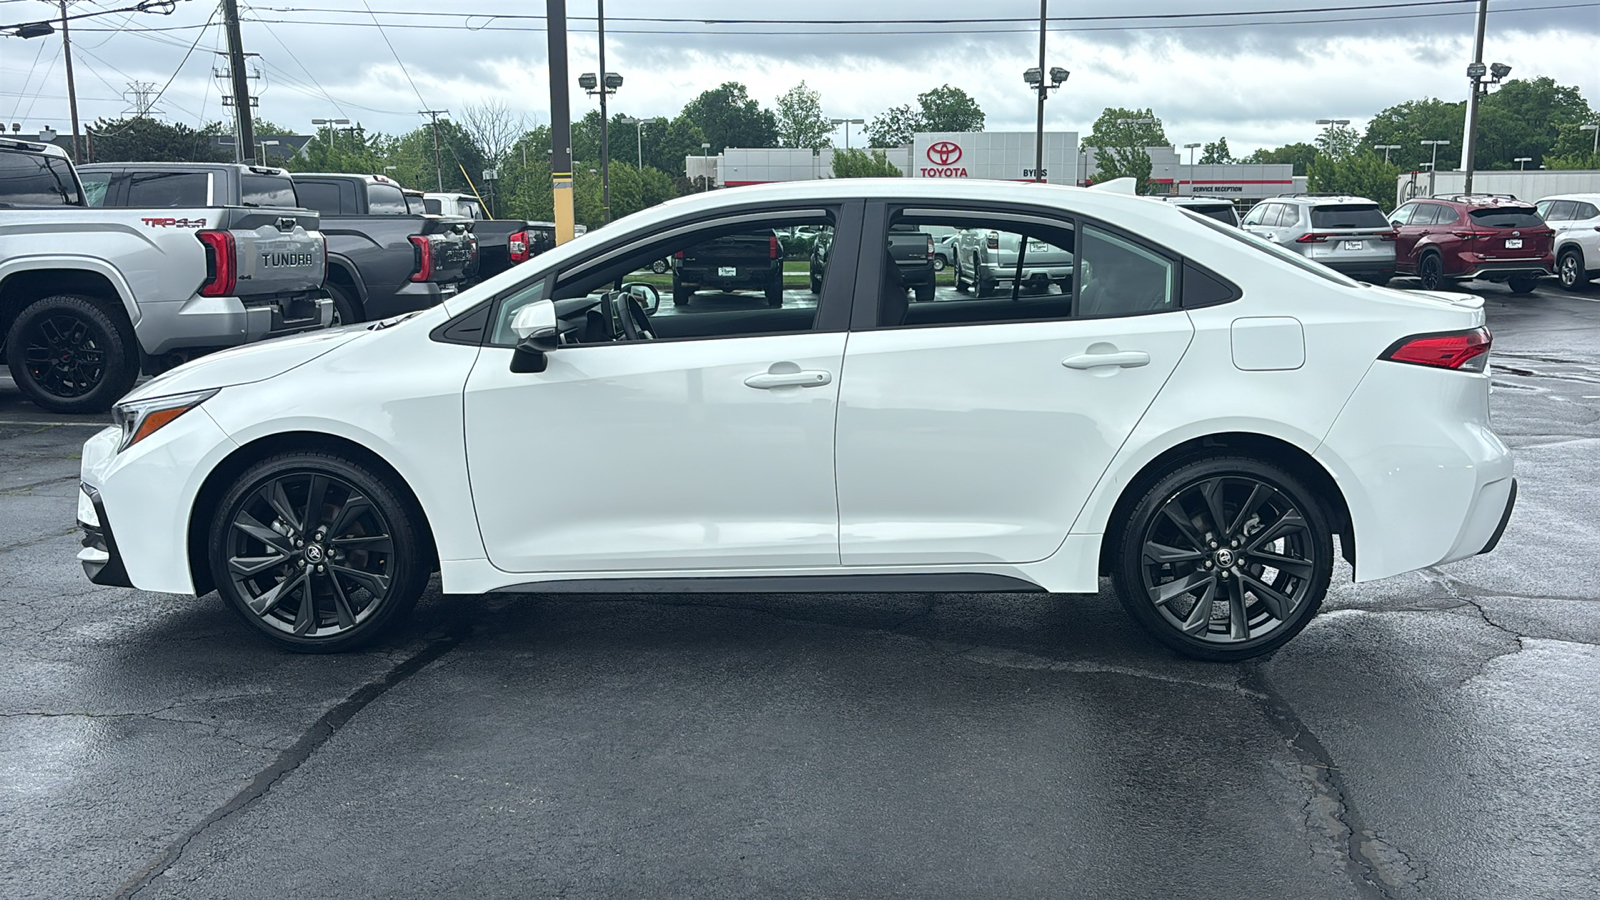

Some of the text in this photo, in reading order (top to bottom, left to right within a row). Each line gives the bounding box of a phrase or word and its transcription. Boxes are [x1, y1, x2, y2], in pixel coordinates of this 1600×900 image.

[920, 167, 968, 177] TOYOTA
[1023, 169, 1048, 177] BYES
[141, 218, 176, 228] TRD
[261, 253, 313, 268] TUNDRA
